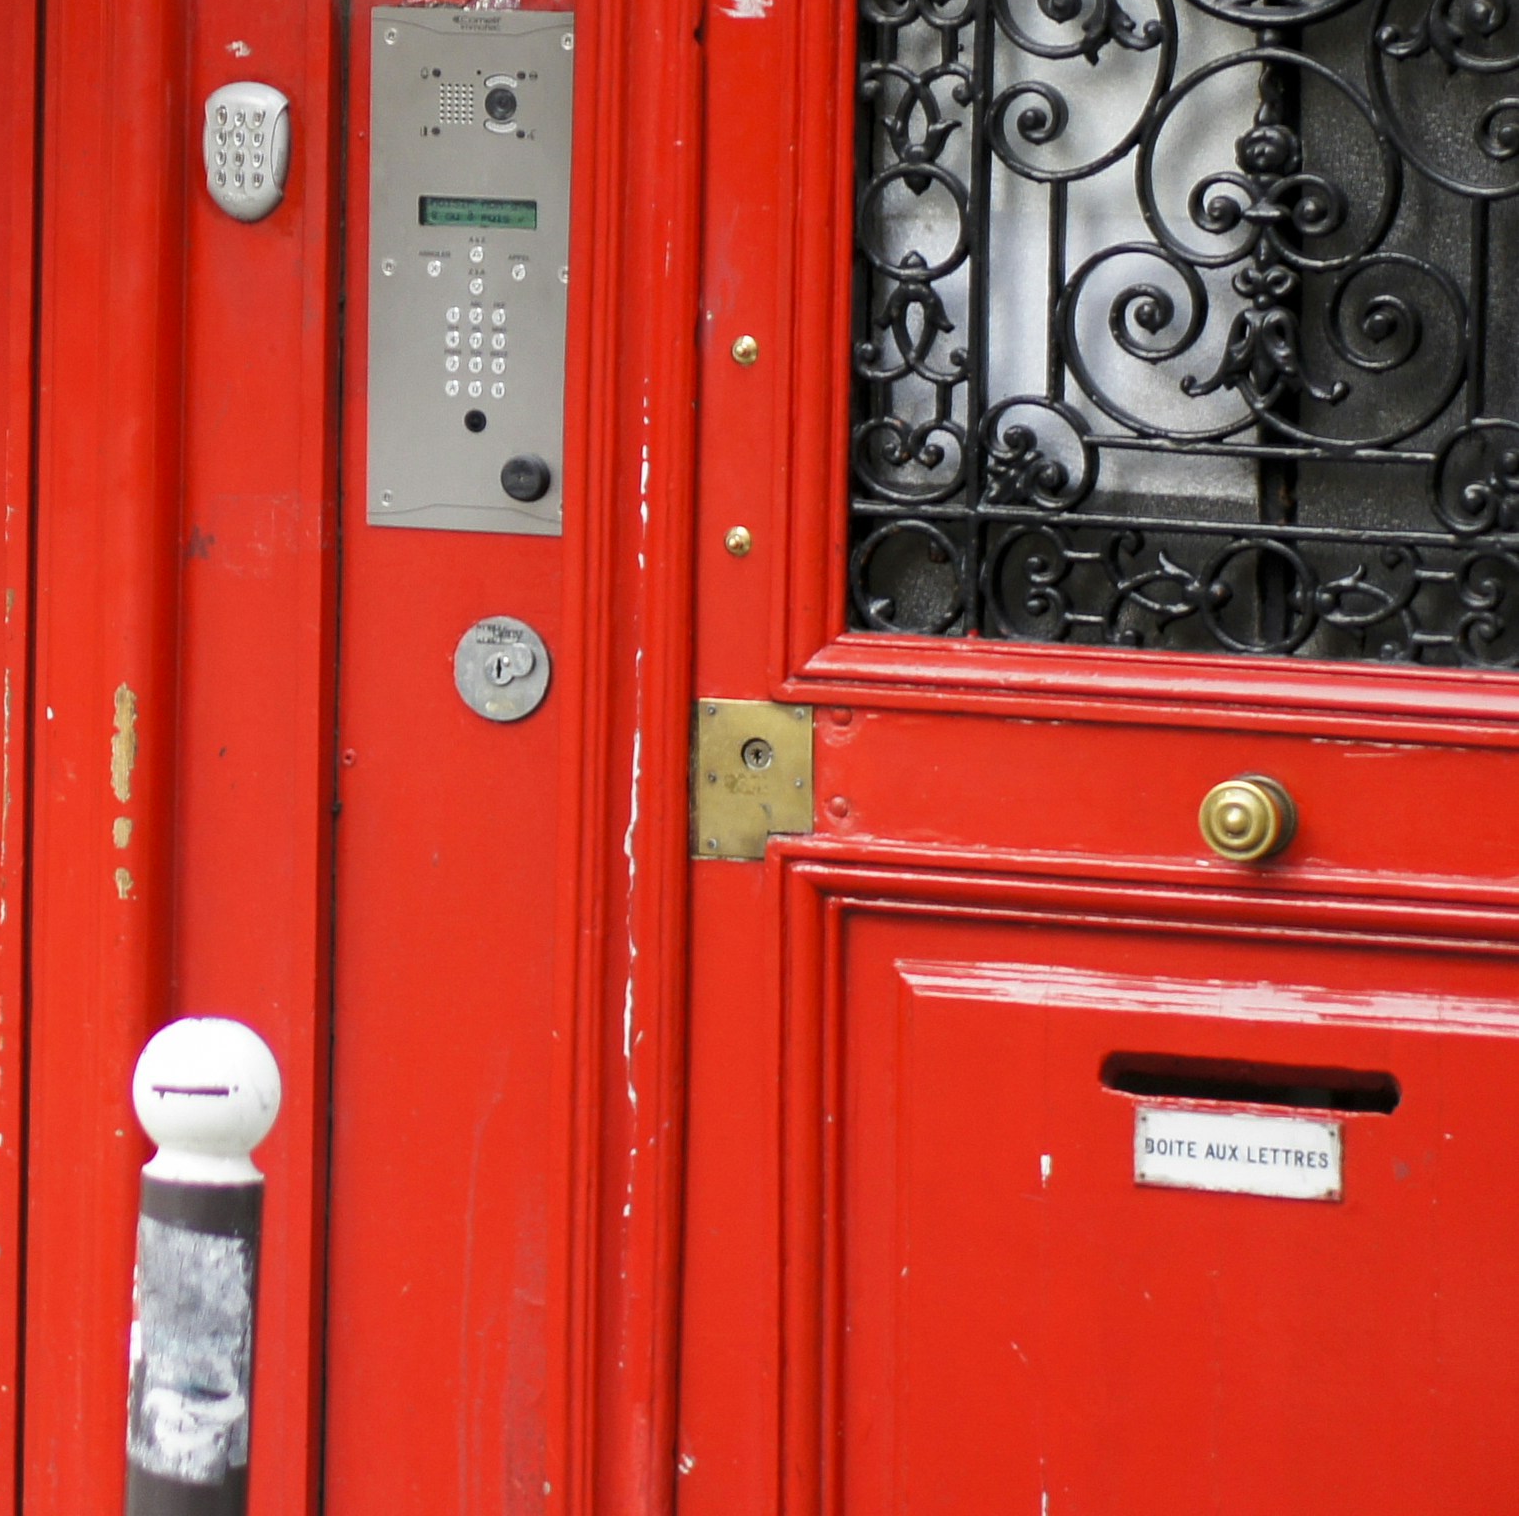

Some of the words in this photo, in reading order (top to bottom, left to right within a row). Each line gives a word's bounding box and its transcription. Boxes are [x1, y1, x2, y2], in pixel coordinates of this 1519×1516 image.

[1144, 1137, 1197, 1159] BOITE
[1204, 1143, 1239, 1163] AUX
[1246, 1148, 1330, 1170] LETTRES
